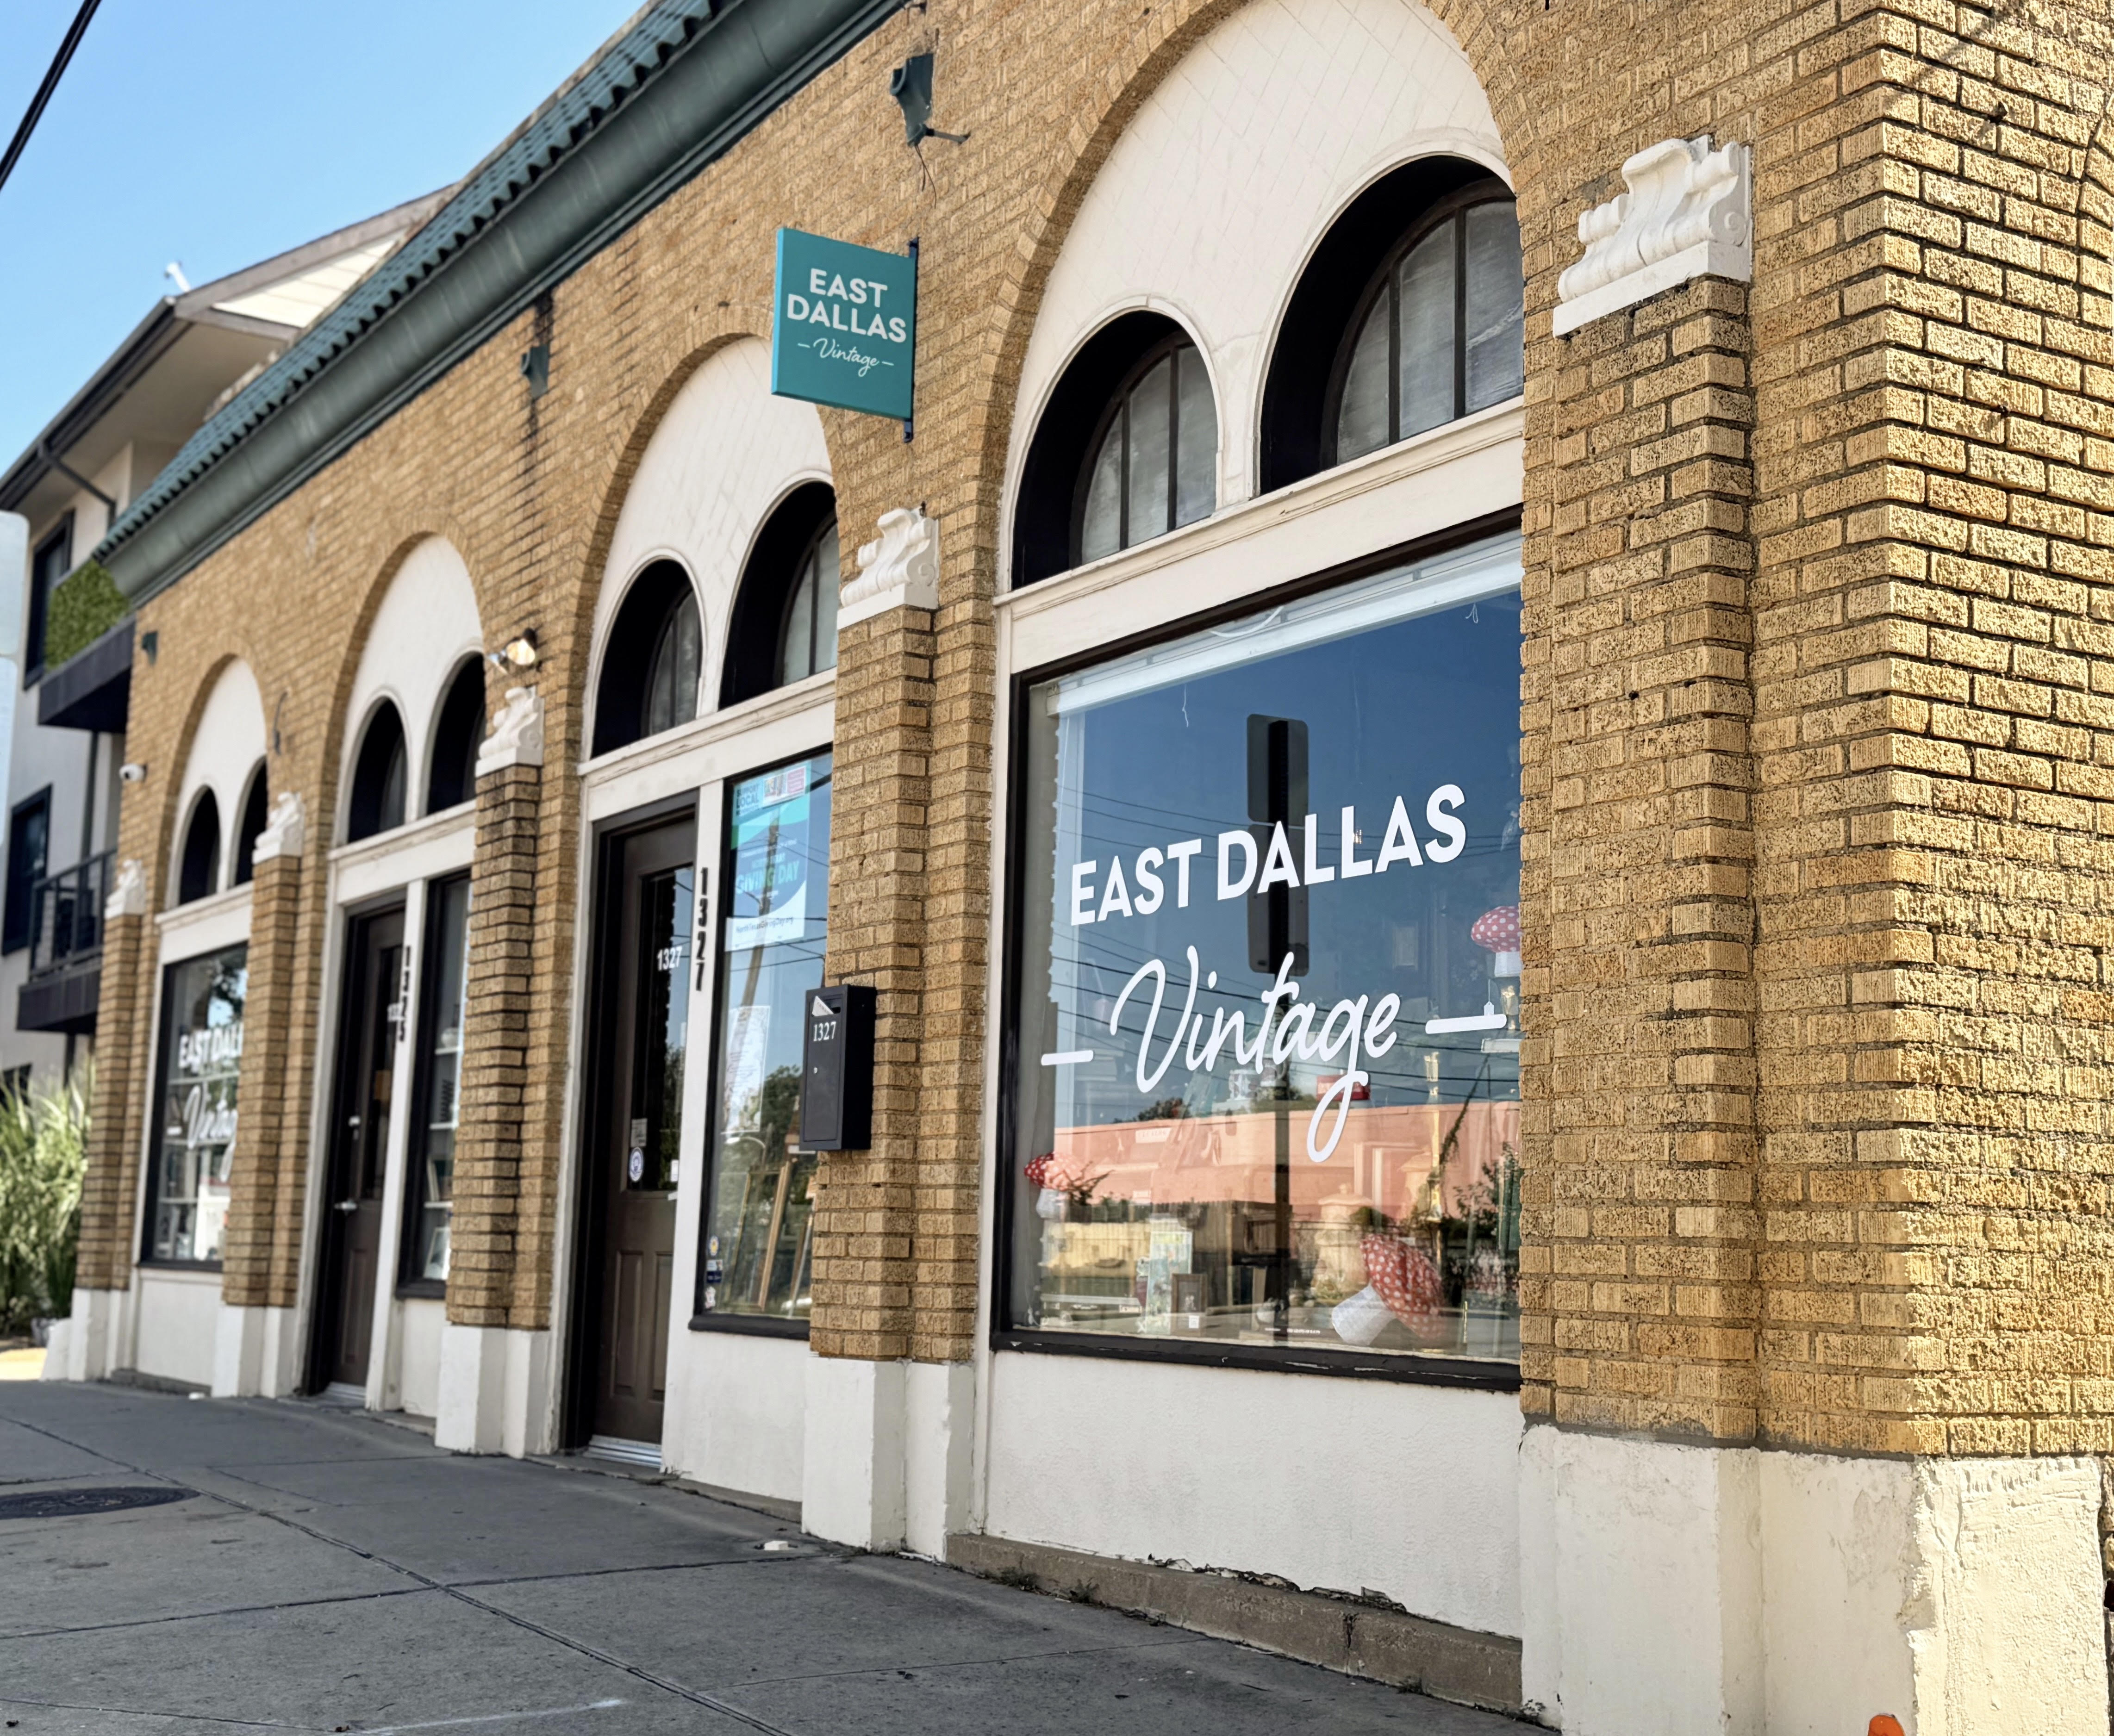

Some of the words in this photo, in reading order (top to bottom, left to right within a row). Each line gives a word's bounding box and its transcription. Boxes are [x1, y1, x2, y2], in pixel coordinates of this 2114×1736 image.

[810, 268, 888, 307] EAST
[787, 293, 906, 342] DALLAS
[813, 338, 879, 377] Vintage
[736, 793, 760, 809] LOCAL
[1071, 838, 1202, 926] EAST
[1217, 784, 1466, 900] DALLAS
[736, 867, 775, 894] GIVING
[778, 859, 799, 884] DAY
[696, 867, 708, 992] 1327
[657, 946, 683, 971] 1327
[179, 1030, 211, 1068] EAST
[813, 1021, 836, 1041] 1327
[1110, 945, 1401, 1162] Vintage
